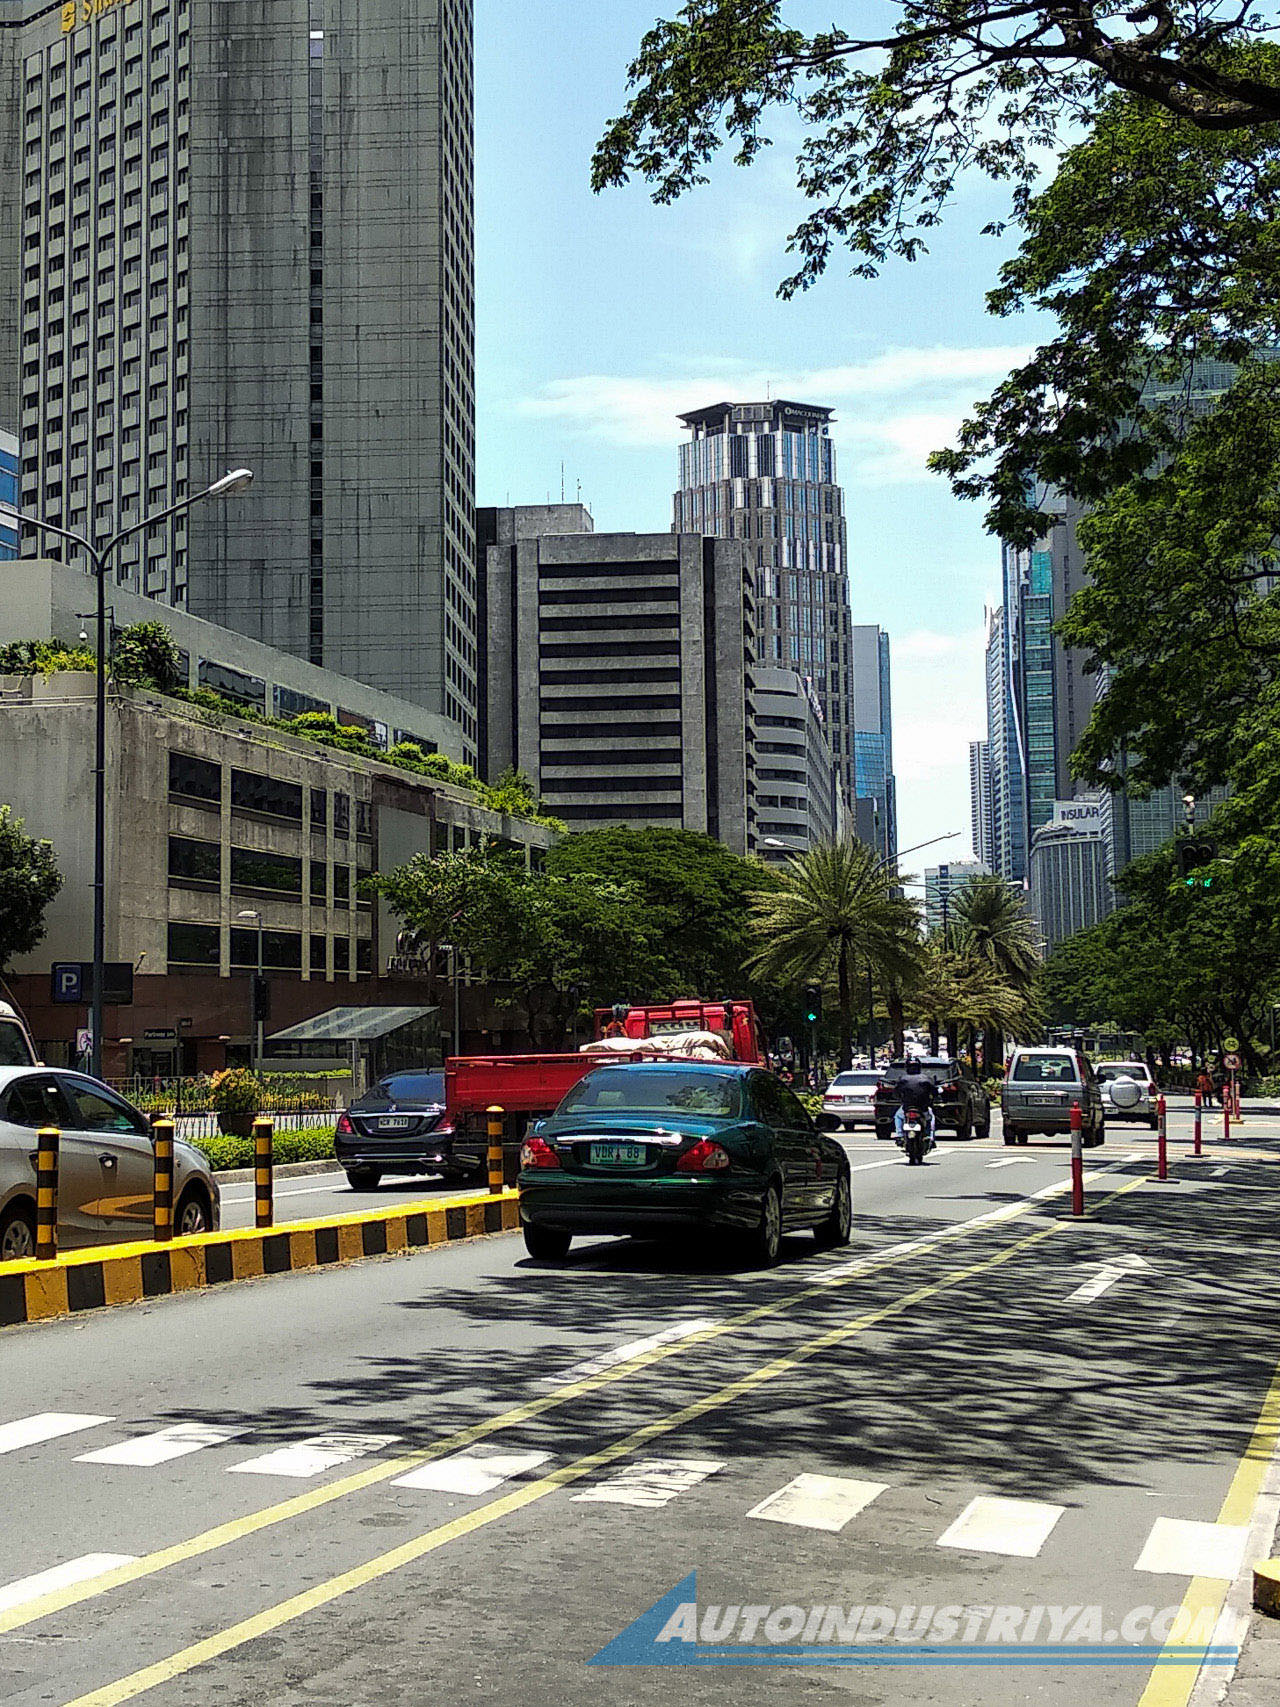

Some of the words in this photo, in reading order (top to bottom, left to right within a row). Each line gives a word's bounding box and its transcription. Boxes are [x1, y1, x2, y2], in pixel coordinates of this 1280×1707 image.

[1061, 807, 1099, 820] INSULAR
[61, 973, 77, 993] P
[626, 1146, 640, 1159] 88
